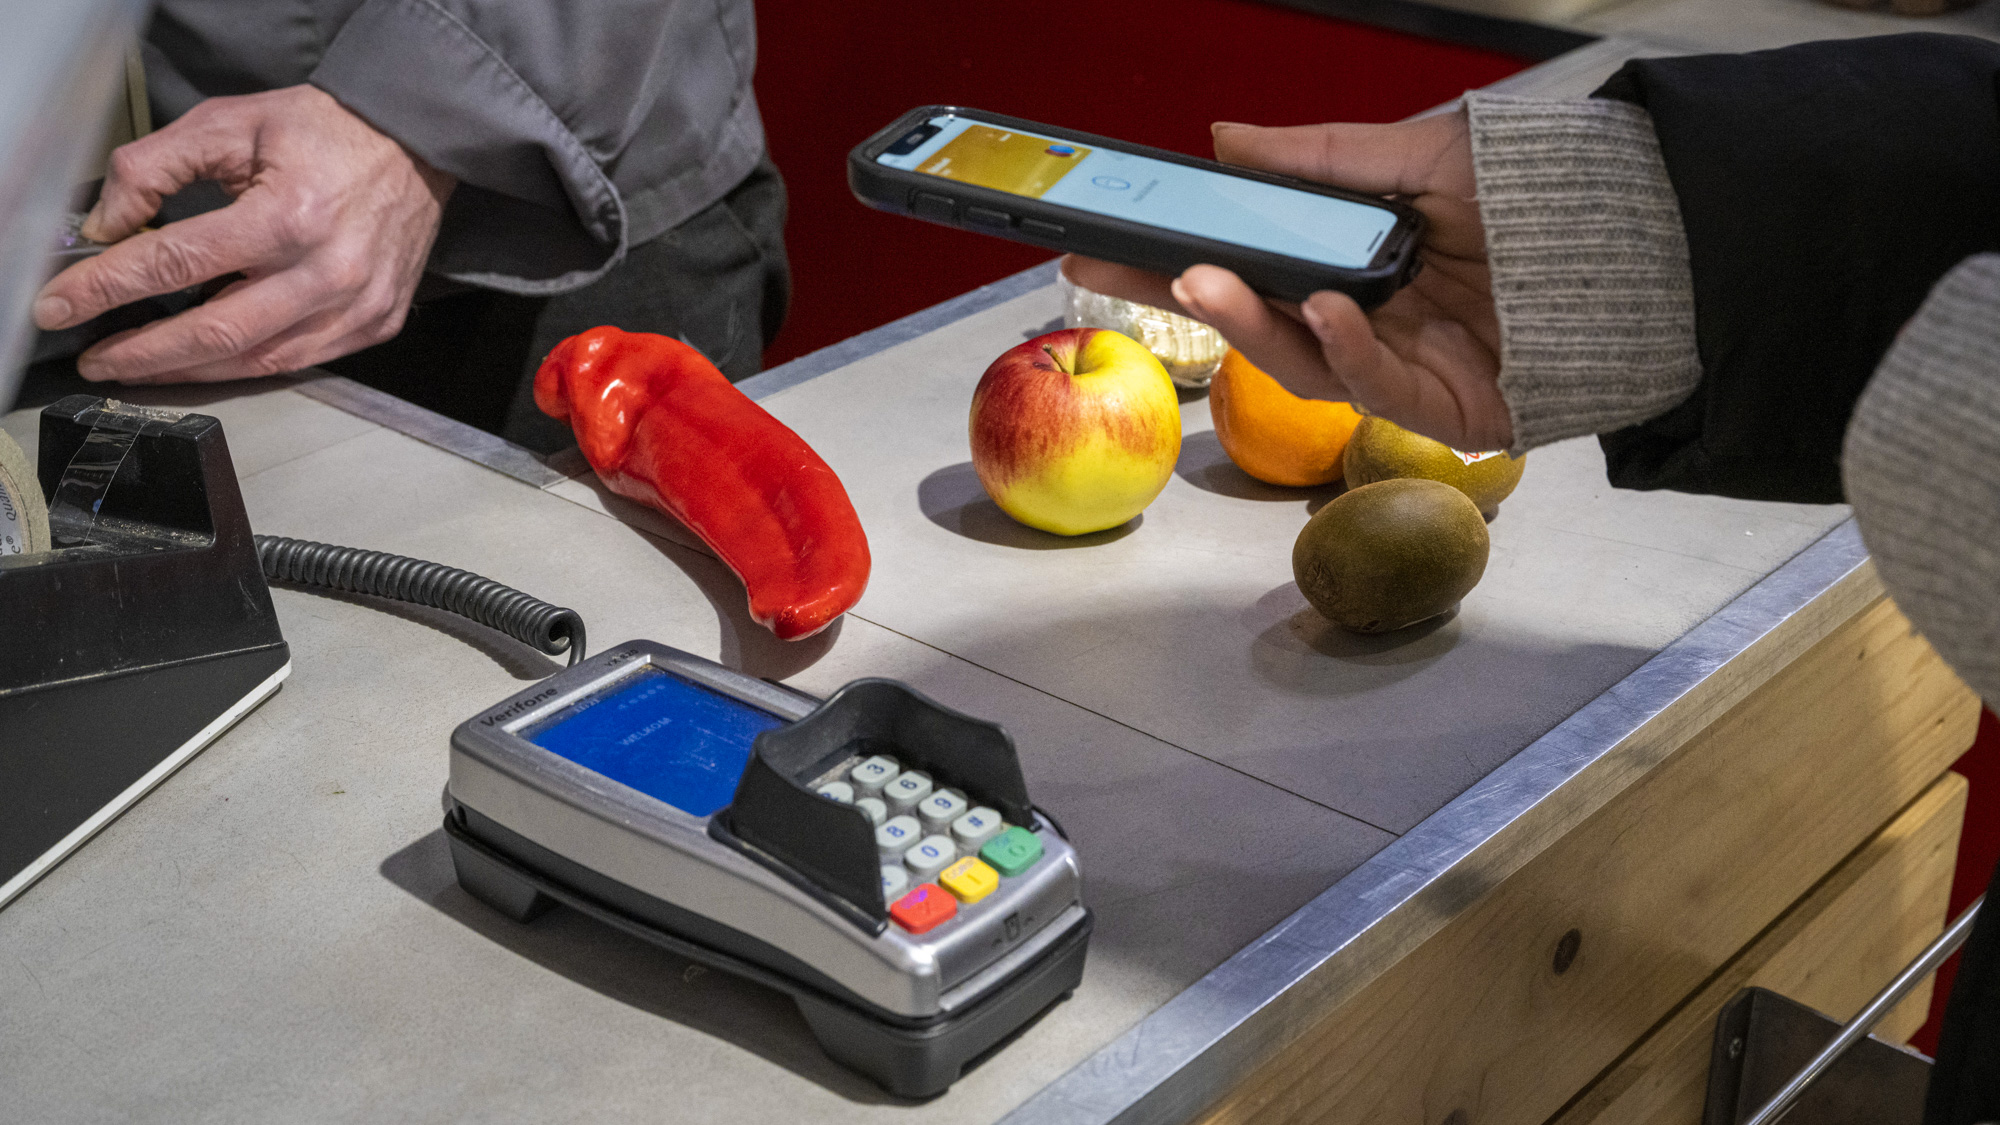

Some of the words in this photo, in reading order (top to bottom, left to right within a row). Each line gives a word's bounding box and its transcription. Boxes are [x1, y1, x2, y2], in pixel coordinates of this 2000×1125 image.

[480, 687, 558, 728] Verifone
[619, 716, 673, 746] WELKOM
[866, 763, 885, 774] 3
[900, 778, 918, 790] 6
[934, 796, 952, 810] 9
[967, 815, 984, 828] #
[886, 825, 905, 838] 8
[921, 845, 940, 858] 0
